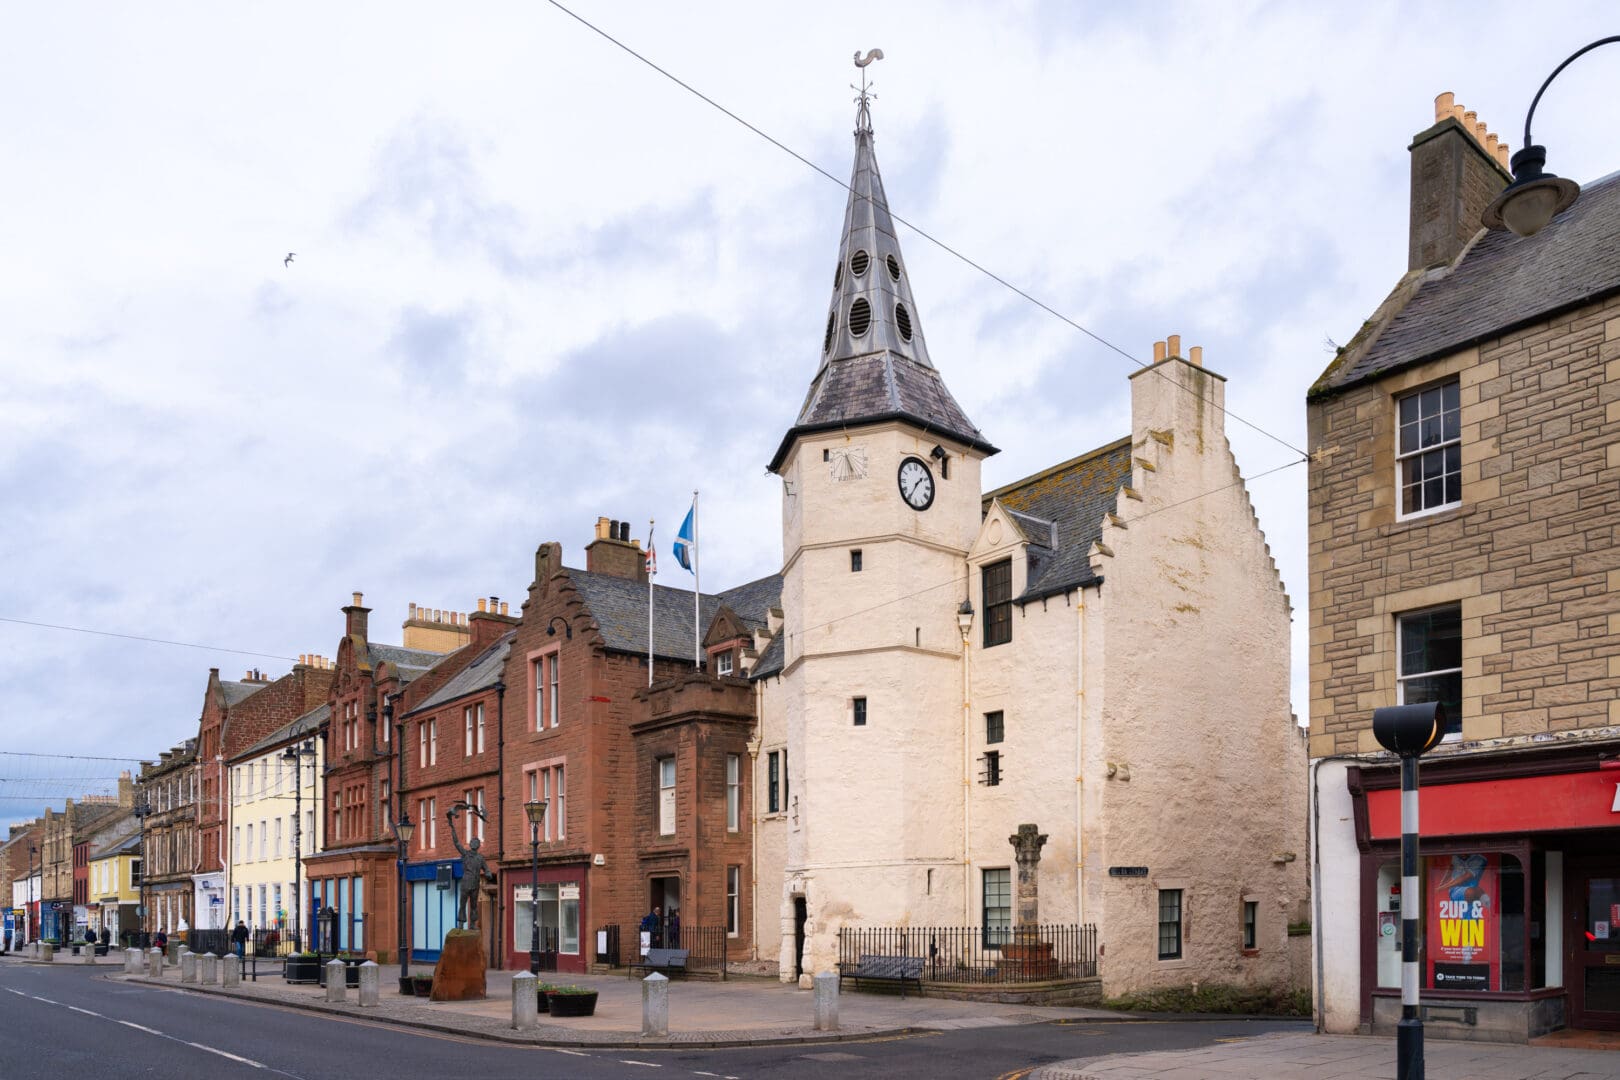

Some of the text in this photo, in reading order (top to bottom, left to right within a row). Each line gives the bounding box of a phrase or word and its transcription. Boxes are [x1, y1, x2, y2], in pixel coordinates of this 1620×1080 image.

[1440, 900, 1484, 918] 2UP &
[1440, 919, 1484, 947] WIN
